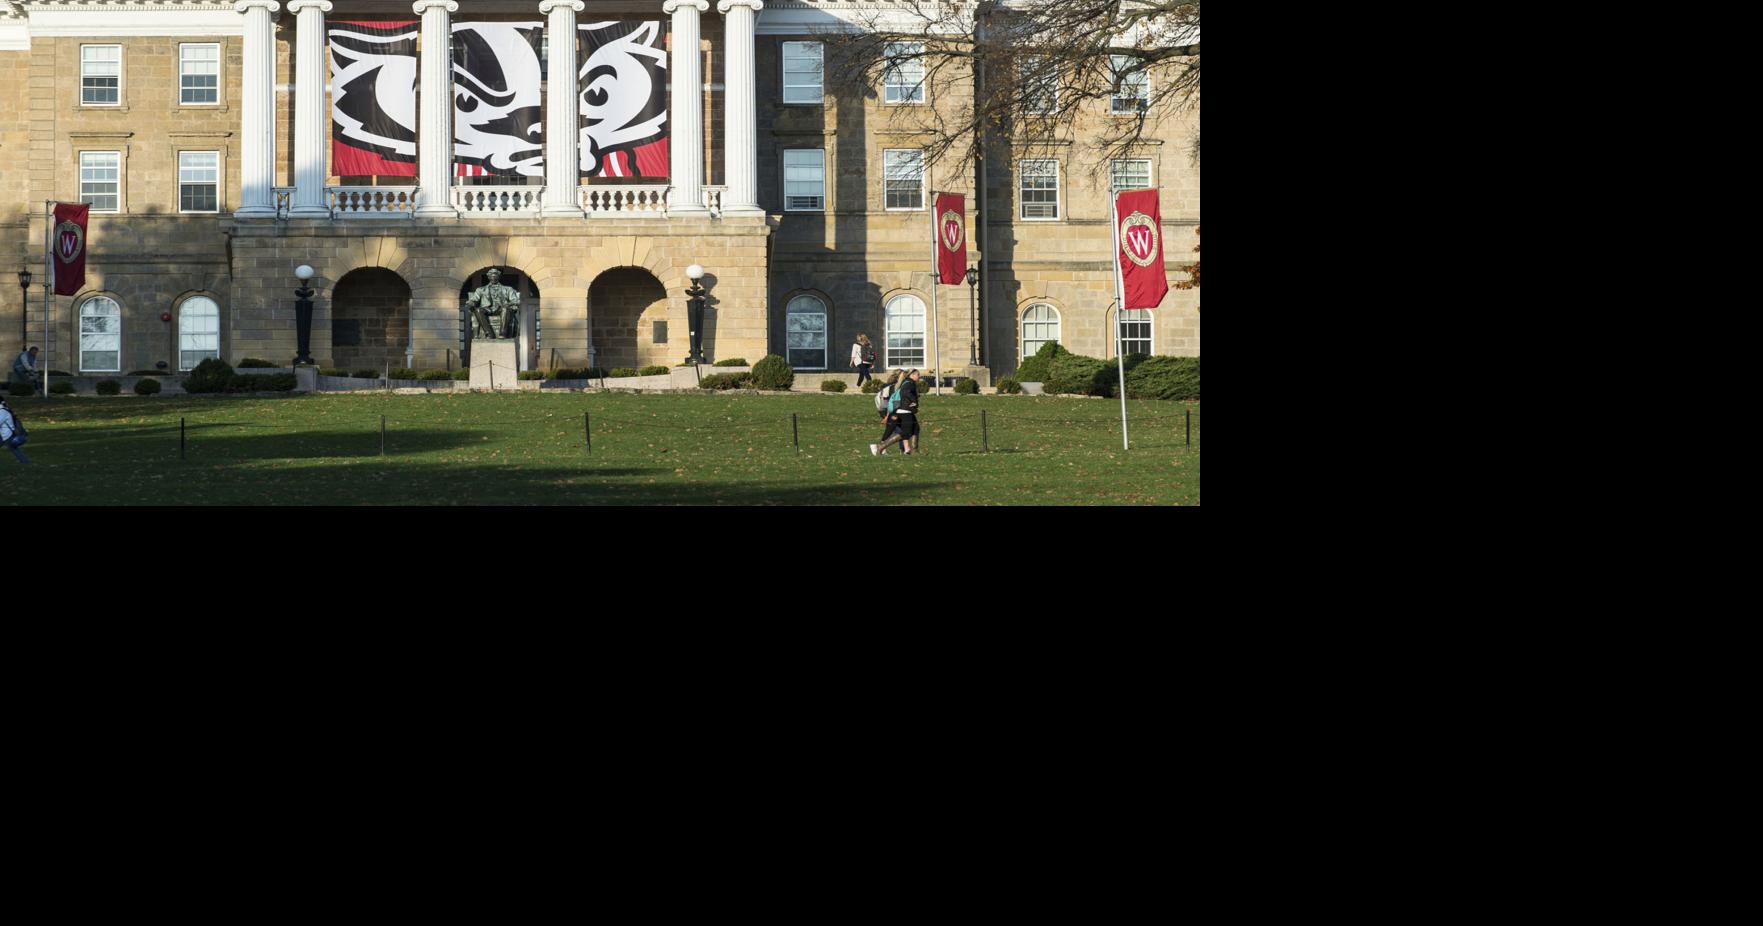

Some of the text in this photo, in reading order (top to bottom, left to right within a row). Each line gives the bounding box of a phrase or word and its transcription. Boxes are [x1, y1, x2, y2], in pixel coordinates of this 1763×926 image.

[946, 223, 958, 243] W
[1128, 229, 1149, 255] W
[61, 234, 76, 255] W
